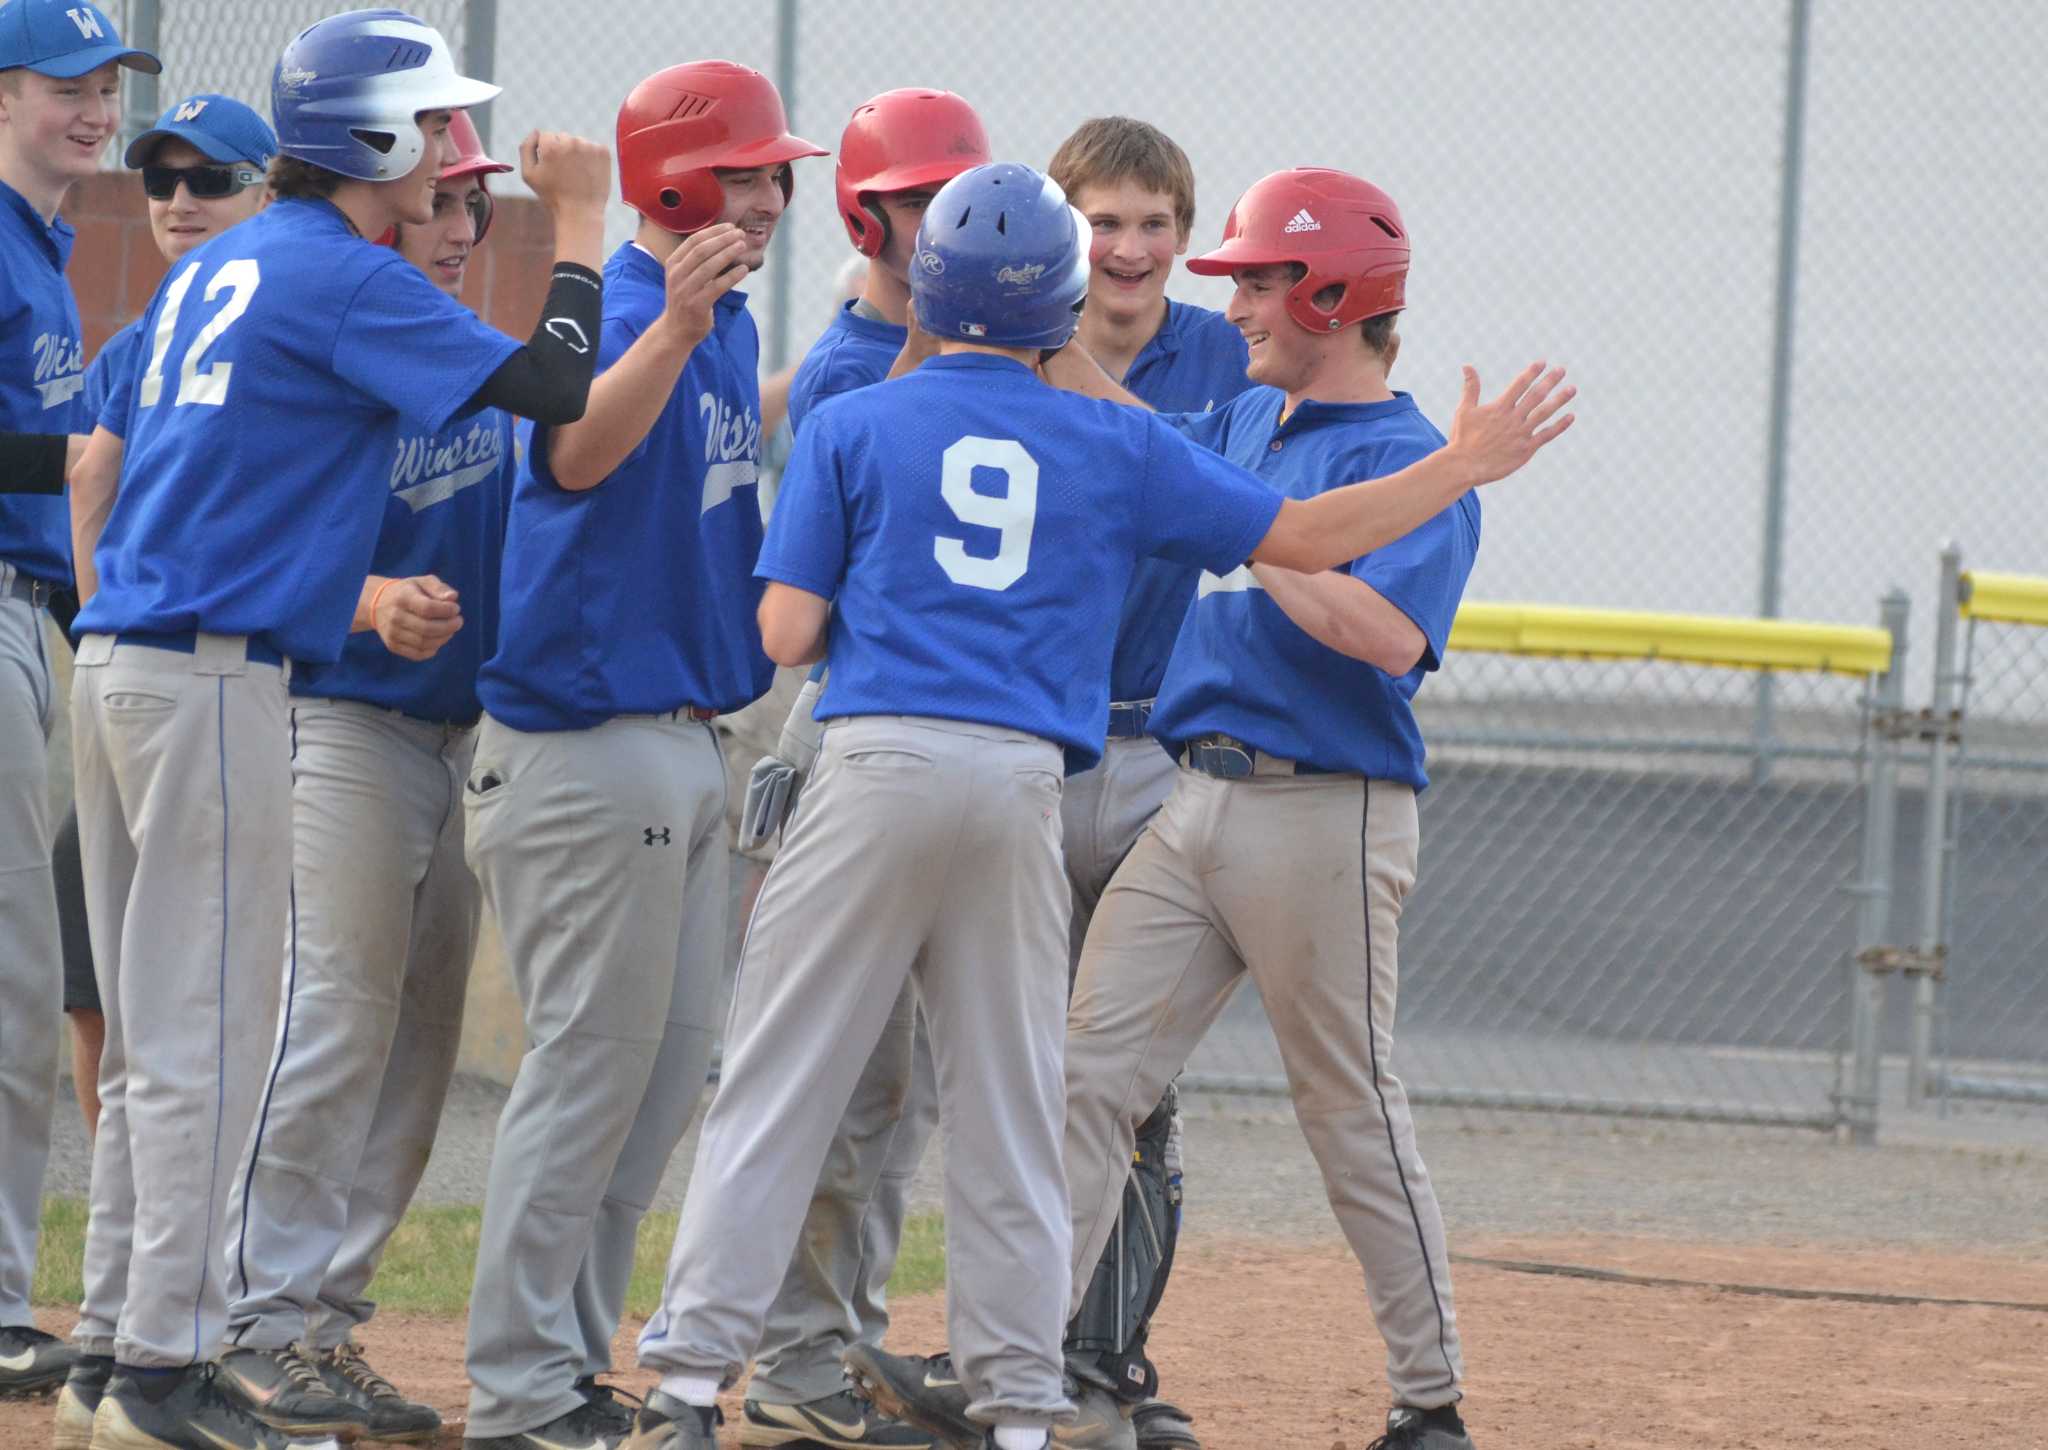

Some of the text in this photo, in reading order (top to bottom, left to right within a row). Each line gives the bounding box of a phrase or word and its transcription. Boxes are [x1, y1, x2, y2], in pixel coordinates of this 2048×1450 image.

[66, 7, 104, 39] W
[173, 100, 208, 123] W
[1284, 219, 1321, 233] adidas
[140, 258, 260, 408] 12
[934, 434, 1039, 592] 9
